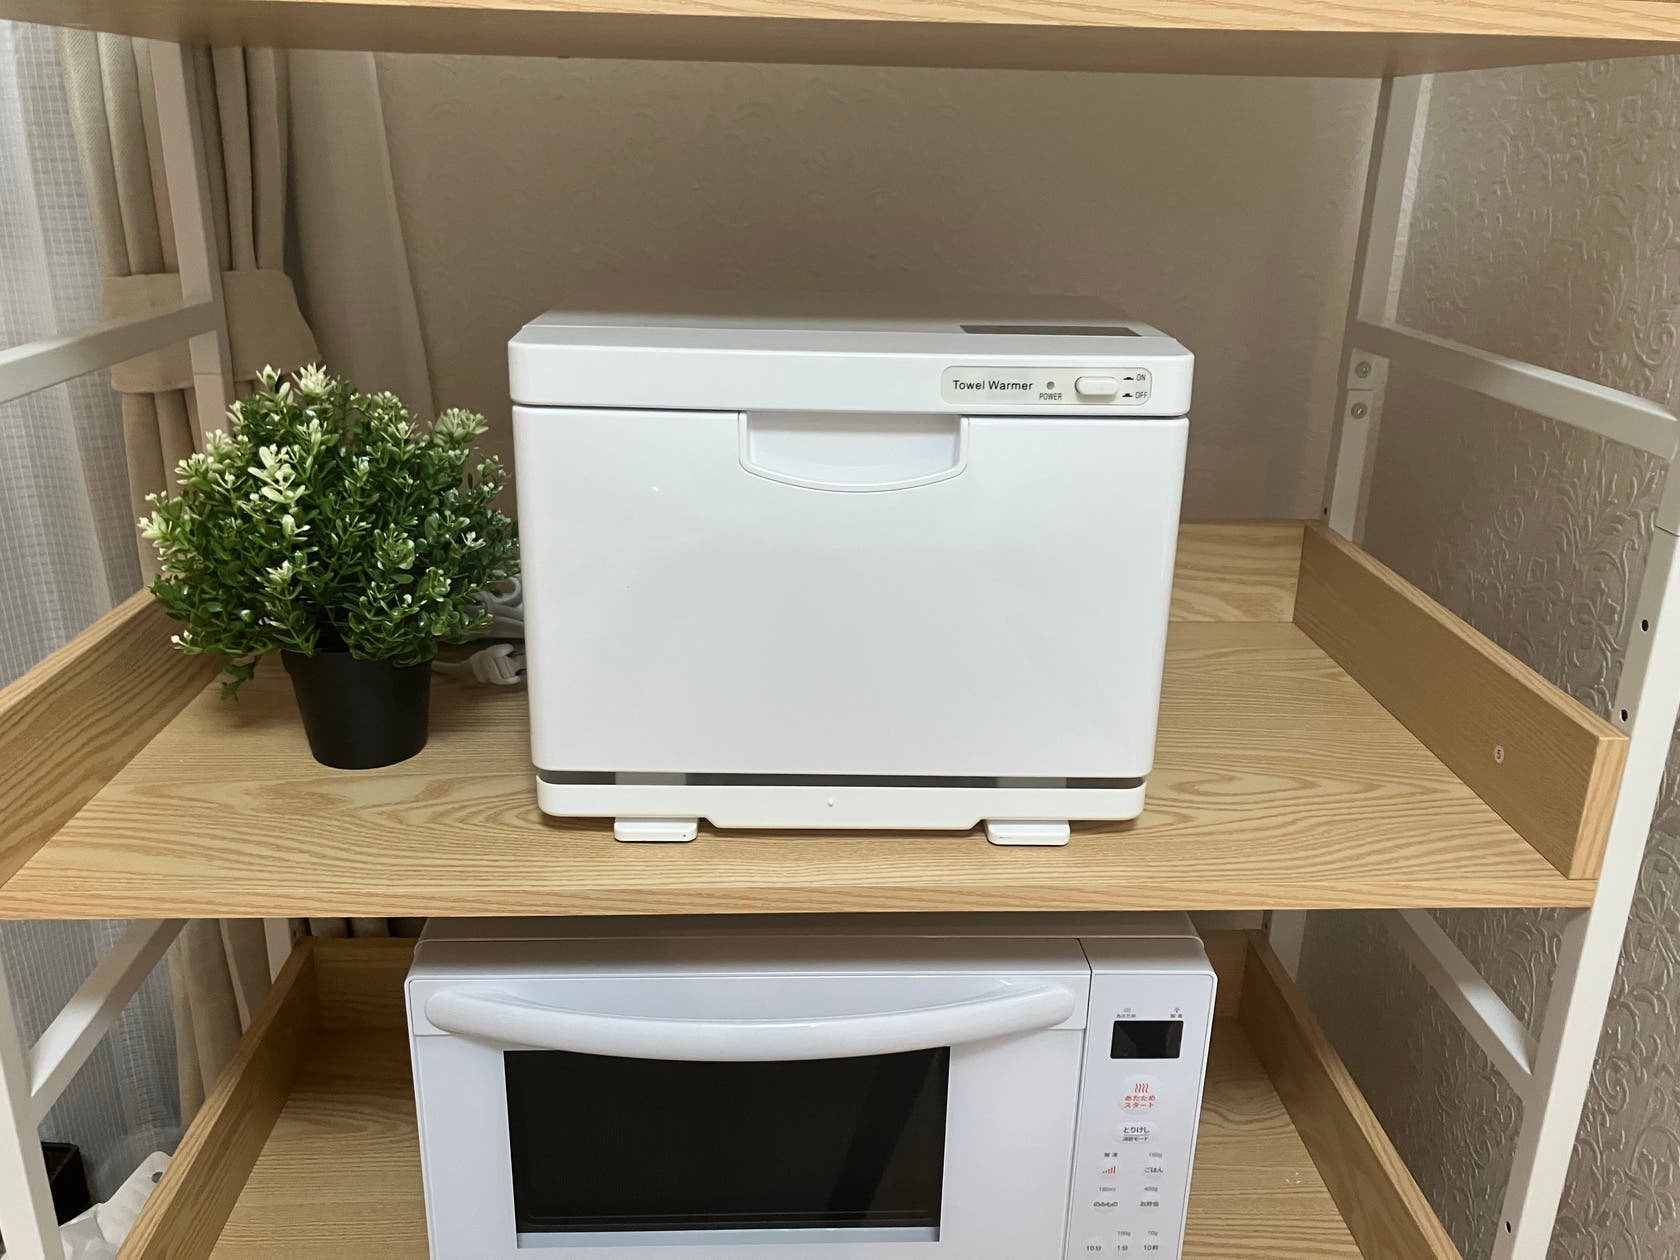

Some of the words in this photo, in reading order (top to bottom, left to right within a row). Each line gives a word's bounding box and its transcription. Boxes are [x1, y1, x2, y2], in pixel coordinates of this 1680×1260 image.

[1136, 373, 1146, 382] ON
[953, 379, 985, 390] Towel
[988, 380, 1033, 391] Warmer
[1039, 392, 1063, 401] POWER
[1135, 391, 1148, 399] OFF
[1123, 1126, 1150, 1134] とりけし
